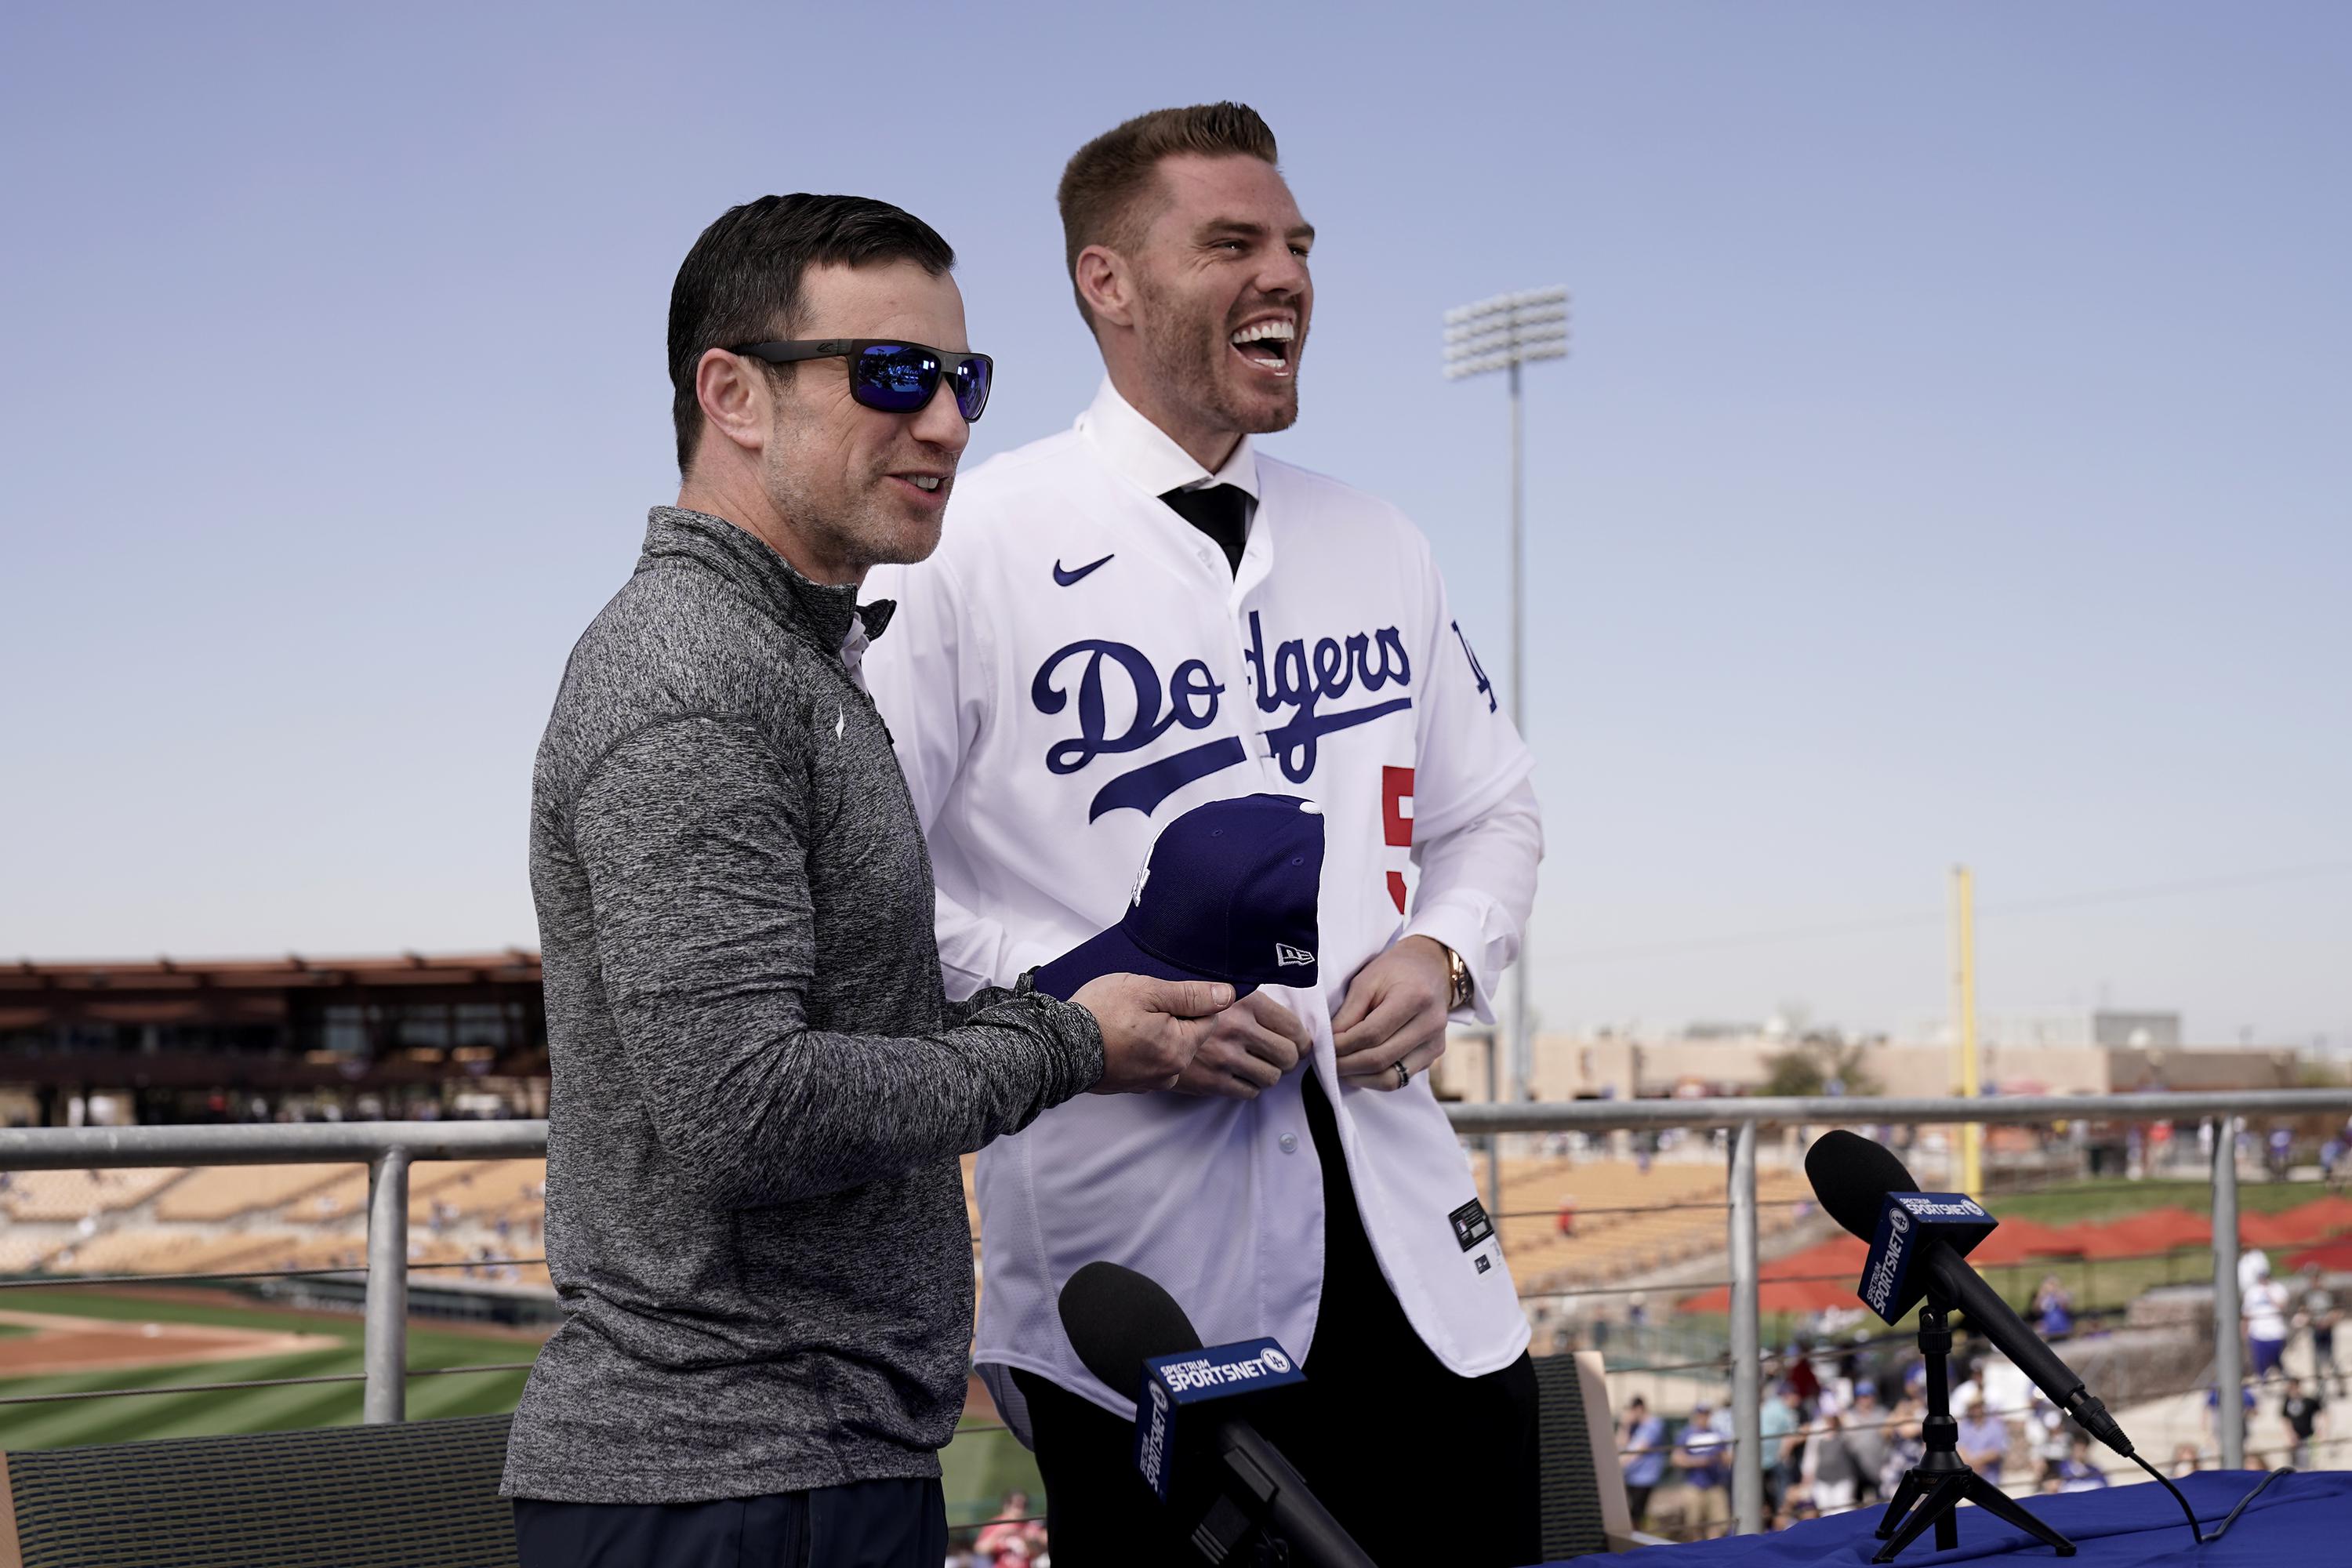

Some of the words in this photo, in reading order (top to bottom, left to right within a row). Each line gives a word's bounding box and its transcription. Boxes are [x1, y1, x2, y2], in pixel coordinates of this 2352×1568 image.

[1905, 1204, 1970, 1215] SPORTSNET
[1867, 1261, 1882, 1301] SPECTRUM
[1873, 1228, 1904, 1315] SPORTSNET
[1160, 1359, 1211, 1376] SPECTRUM
[1166, 1358, 1268, 1392] SPORTSNET
[1146, 1402, 1166, 1493] SPORTSNET
